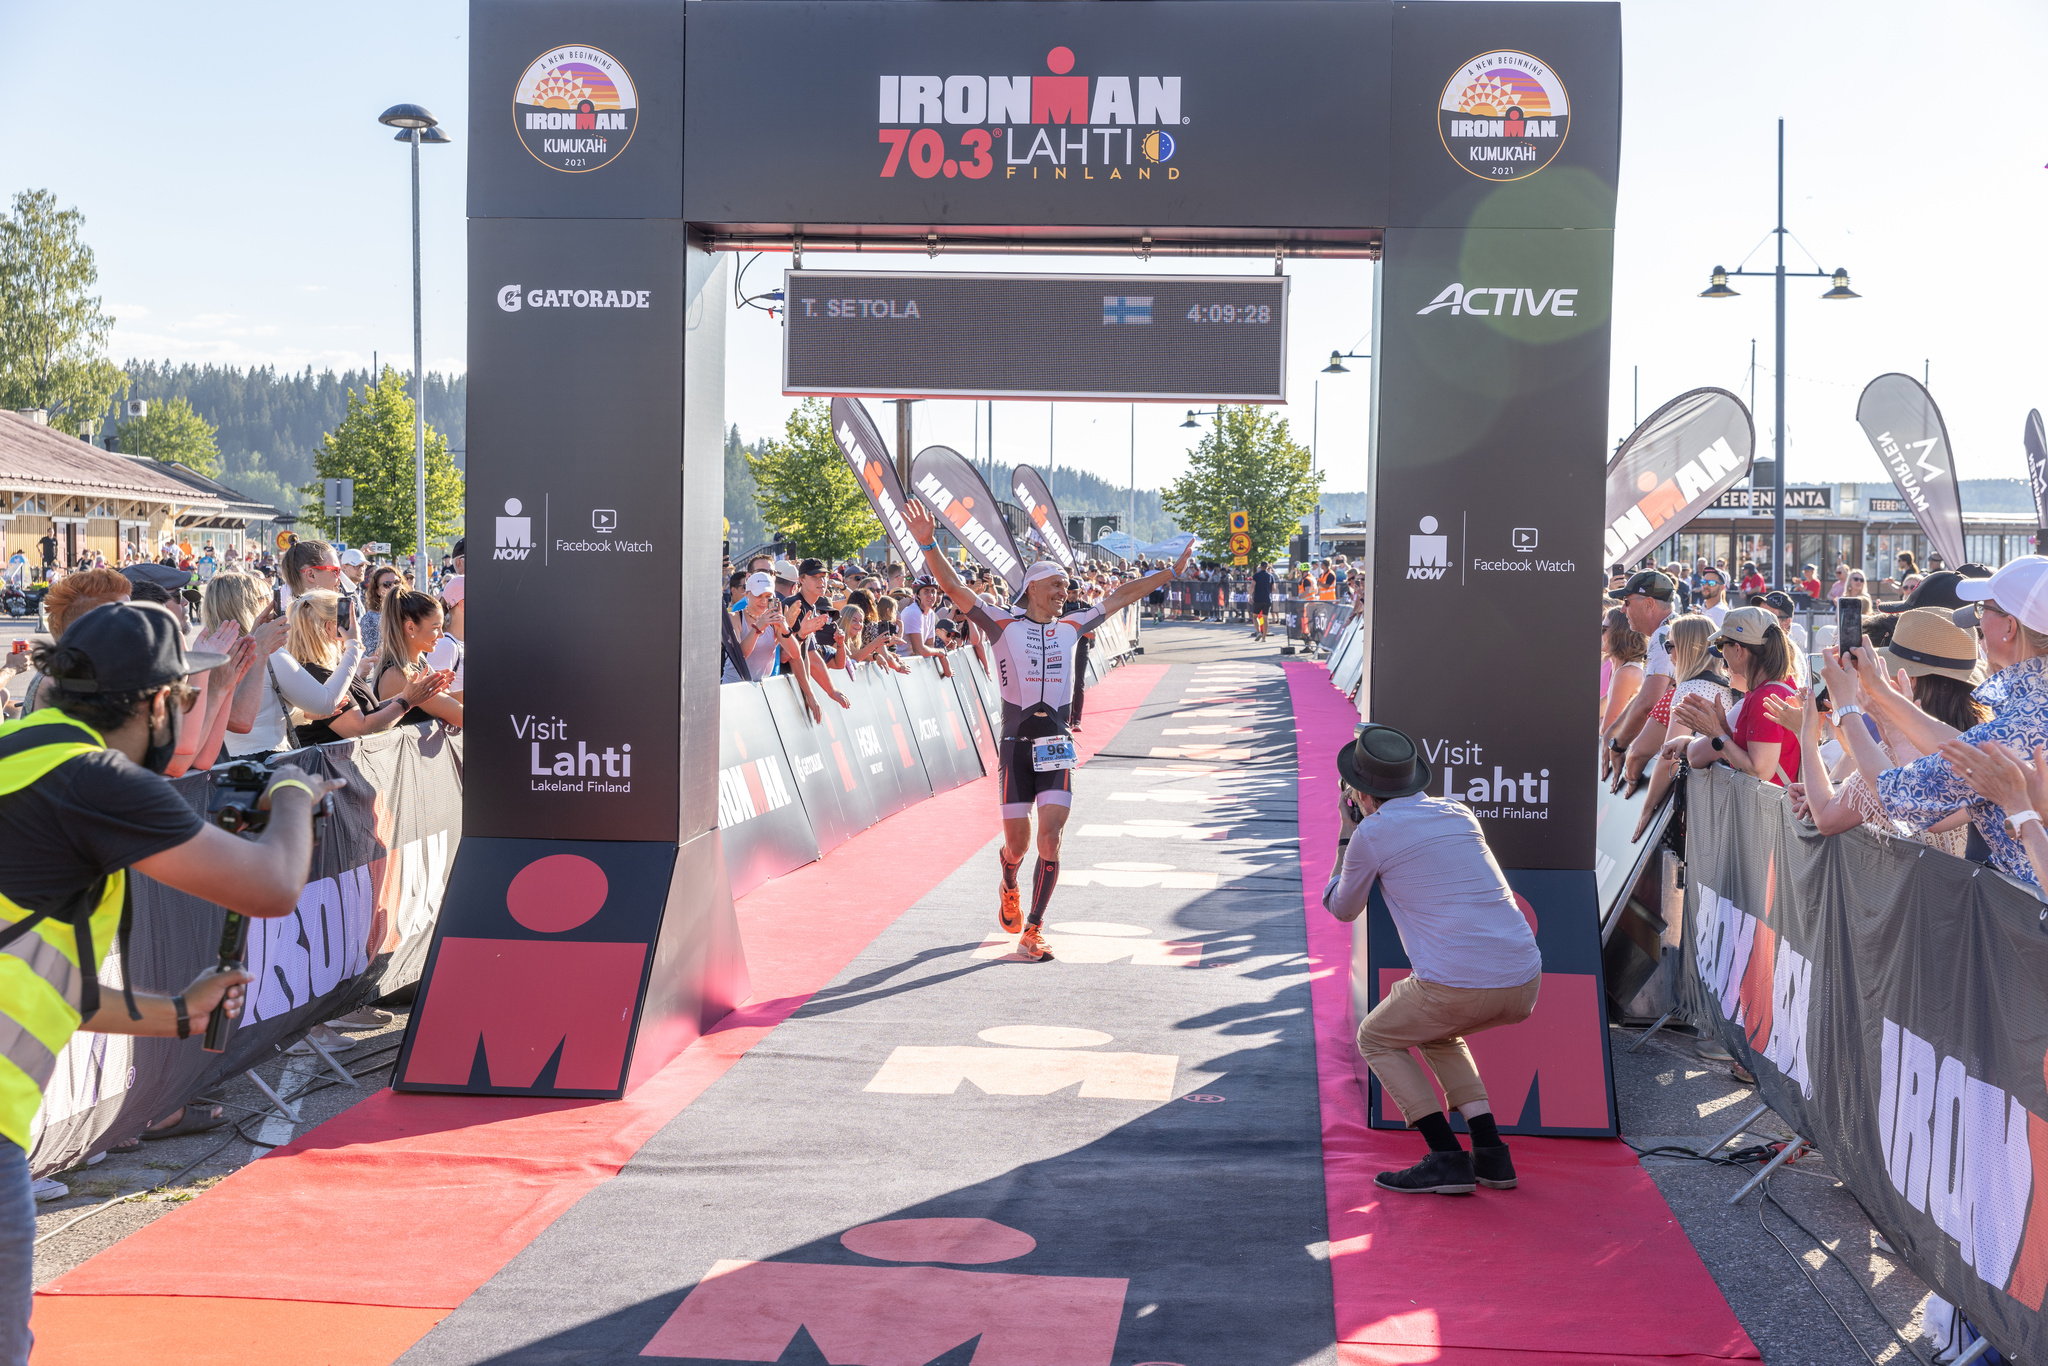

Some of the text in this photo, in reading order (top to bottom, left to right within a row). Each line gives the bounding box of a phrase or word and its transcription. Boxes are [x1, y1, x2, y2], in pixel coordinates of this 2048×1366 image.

[548, 53, 565, 65] NEW
[569, 51, 612, 70] BEGINNING
[1476, 58, 1493, 71] NEW
[1498, 56, 1543, 76] BEGINNING
[878, 46, 1183, 124] IRONMAN
[525, 112, 626, 130] IRONMAN
[1451, 119, 1557, 138] IRONMAN
[878, 127, 1132, 179] 70.3 LAHTI
[565, 159, 586, 167] 2021
[1491, 166, 1514, 175] 2021
[1007, 166, 1180, 180] FINLAND
[527, 289, 651, 308] GATORADE
[1416, 282, 1578, 317] ACTIVE
[801, 298, 921, 319] T. SETOLA
[1186, 304, 1271, 324] 4:09:28
[1604, 436, 1741, 570] ONMAN
[493, 549, 530, 560] NOW
[556, 539, 653, 552] Facebook Watch
[1406, 567, 1446, 580] NOW
[1474, 558, 1576, 572] Facebook Watch
[1026, 643, 1059, 651] GARMIN
[510, 714, 568, 741] Visit
[1047, 743, 1065, 756] 96
[1422, 738, 1483, 765] Visit
[531, 741, 632, 778] Lahti
[531, 779, 631, 793] Lakeland Finland
[1443, 766, 1550, 804] Lahti
[1473, 806, 1548, 820] land Finland
